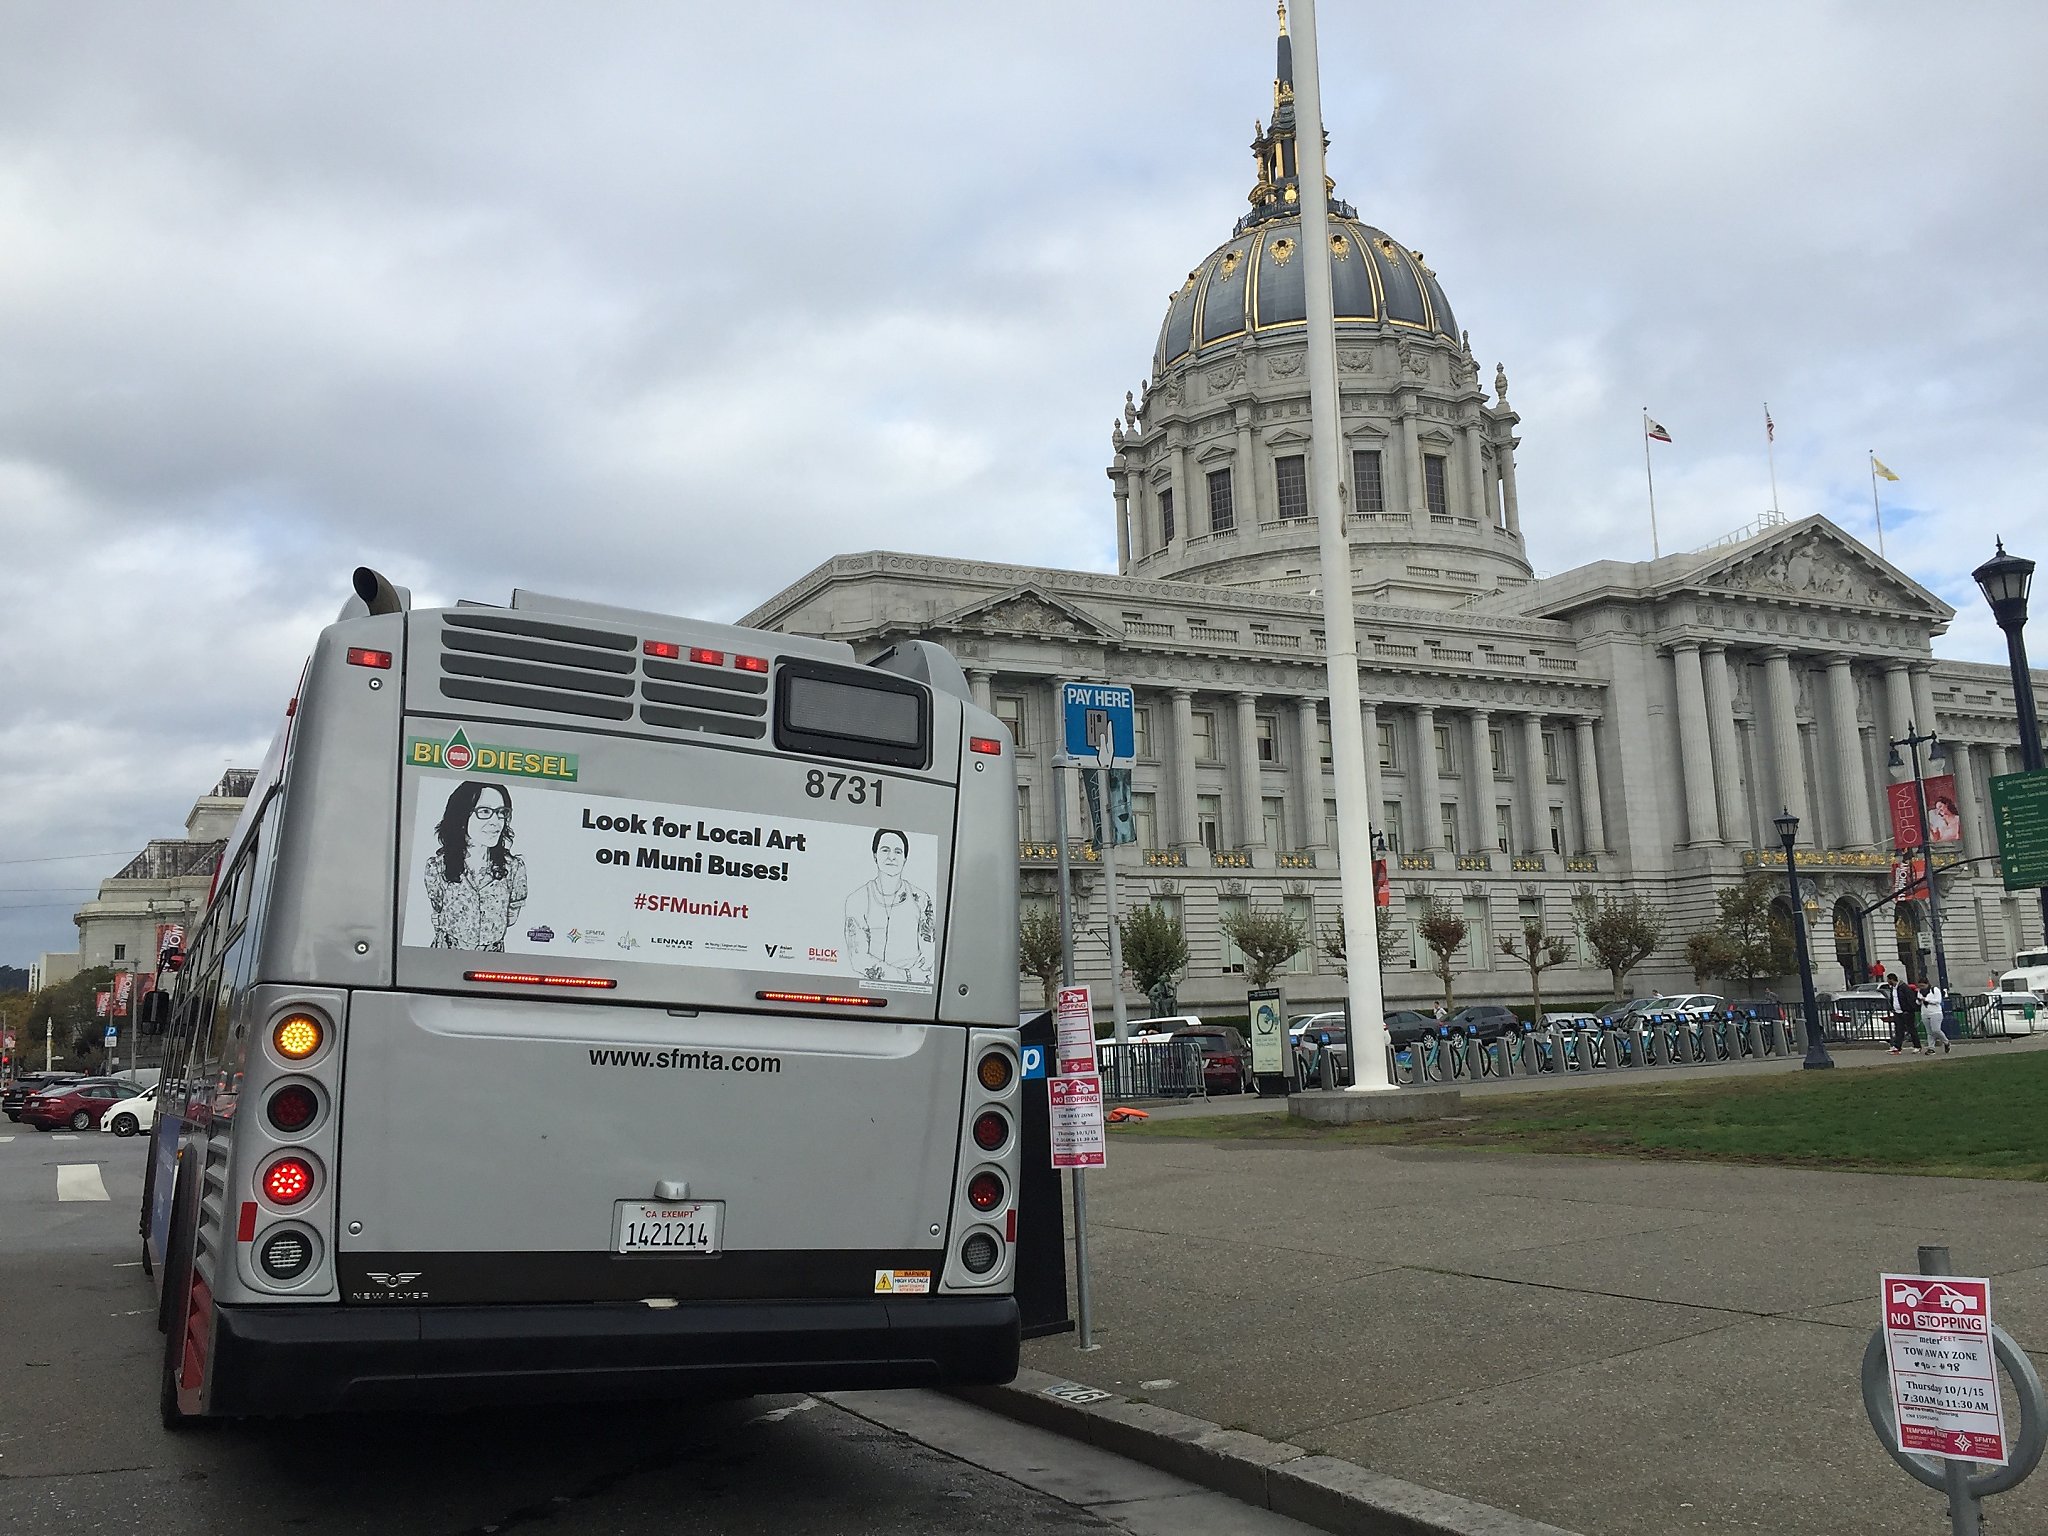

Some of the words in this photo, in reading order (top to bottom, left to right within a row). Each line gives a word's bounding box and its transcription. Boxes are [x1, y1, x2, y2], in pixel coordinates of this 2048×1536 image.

[1067, 688, 1092, 705] PAY
[1095, 690, 1130, 708] HERE
[805, 769, 882, 807] 8731
[1896, 786, 1917, 844] OPERA
[582, 808, 648, 835] Look
[653, 816, 691, 839] for
[696, 821, 762, 847] Local
[766, 829, 806, 851] Art
[595, 848, 630, 866] on
[636, 847, 702, 873] Muni
[707, 854, 789, 882] Buses!
[633, 893, 749, 919] #SFMuniArt
[651, 937, 693, 946] LENNAR
[808, 947, 838, 958] BLICK
[589, 1049, 781, 1072] www.sfmta.com
[1065, 1094, 1098, 1103] STOPPING
[625, 1222, 709, 1246] 1421214
[1891, 1313, 1910, 1325] NO
[1917, 1315, 1982, 1330] STOPPING
[1919, 1336, 1940, 1345] meter
[1903, 1347, 1923, 1356] TOW
[1925, 1349, 1949, 1359] AWAY
[1952, 1351, 1977, 1361] ZONE
[1906, 1381, 1942, 1394] Thursday
[1945, 1386, 1984, 1397] 10/1/15
[1946, 1399, 1972, 1409] 11:30
[1975, 1402, 1989, 1411] AM
[1974, 1436, 1996, 1444] SFMTA
